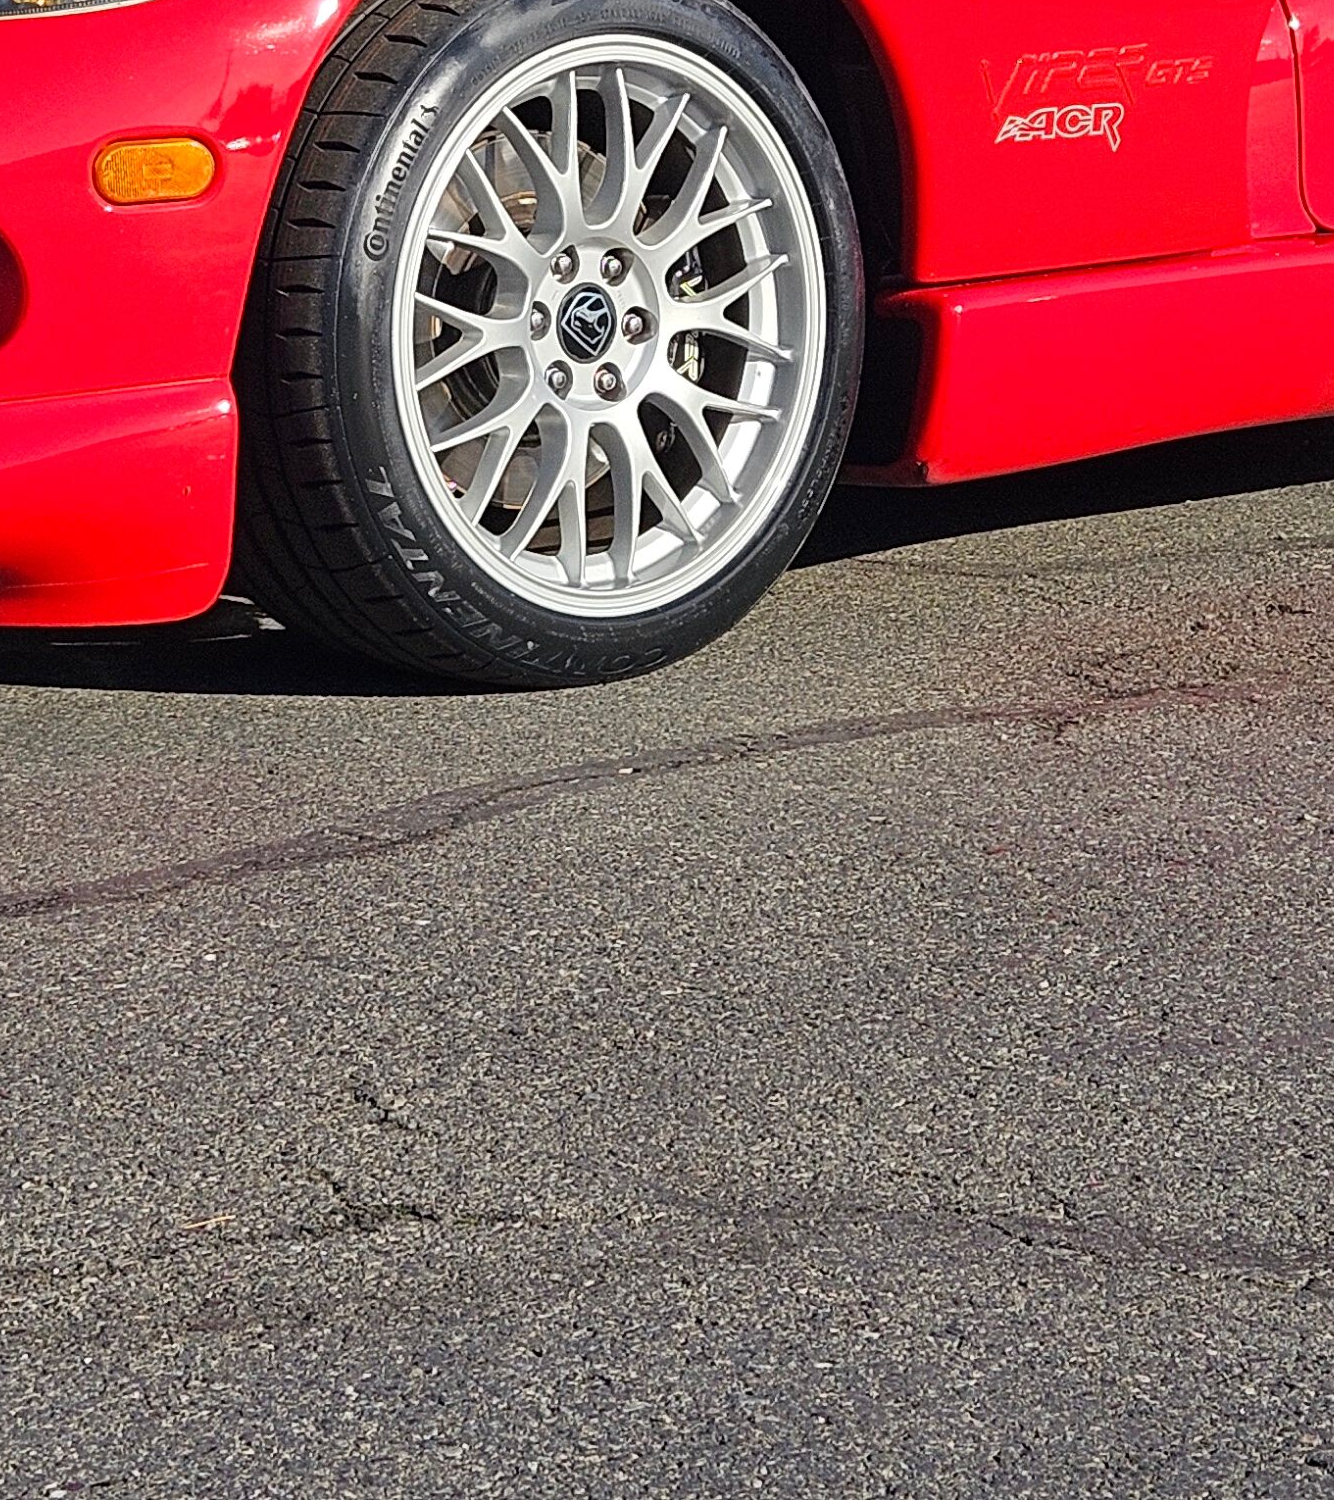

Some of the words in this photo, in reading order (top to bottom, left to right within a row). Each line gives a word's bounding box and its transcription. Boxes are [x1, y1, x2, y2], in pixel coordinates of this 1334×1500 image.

[979, 43, 1148, 122] VIPER
[1146, 56, 1214, 84] GTS
[995, 103, 1125, 152] ACR
[363, 118, 431, 262] Continental
